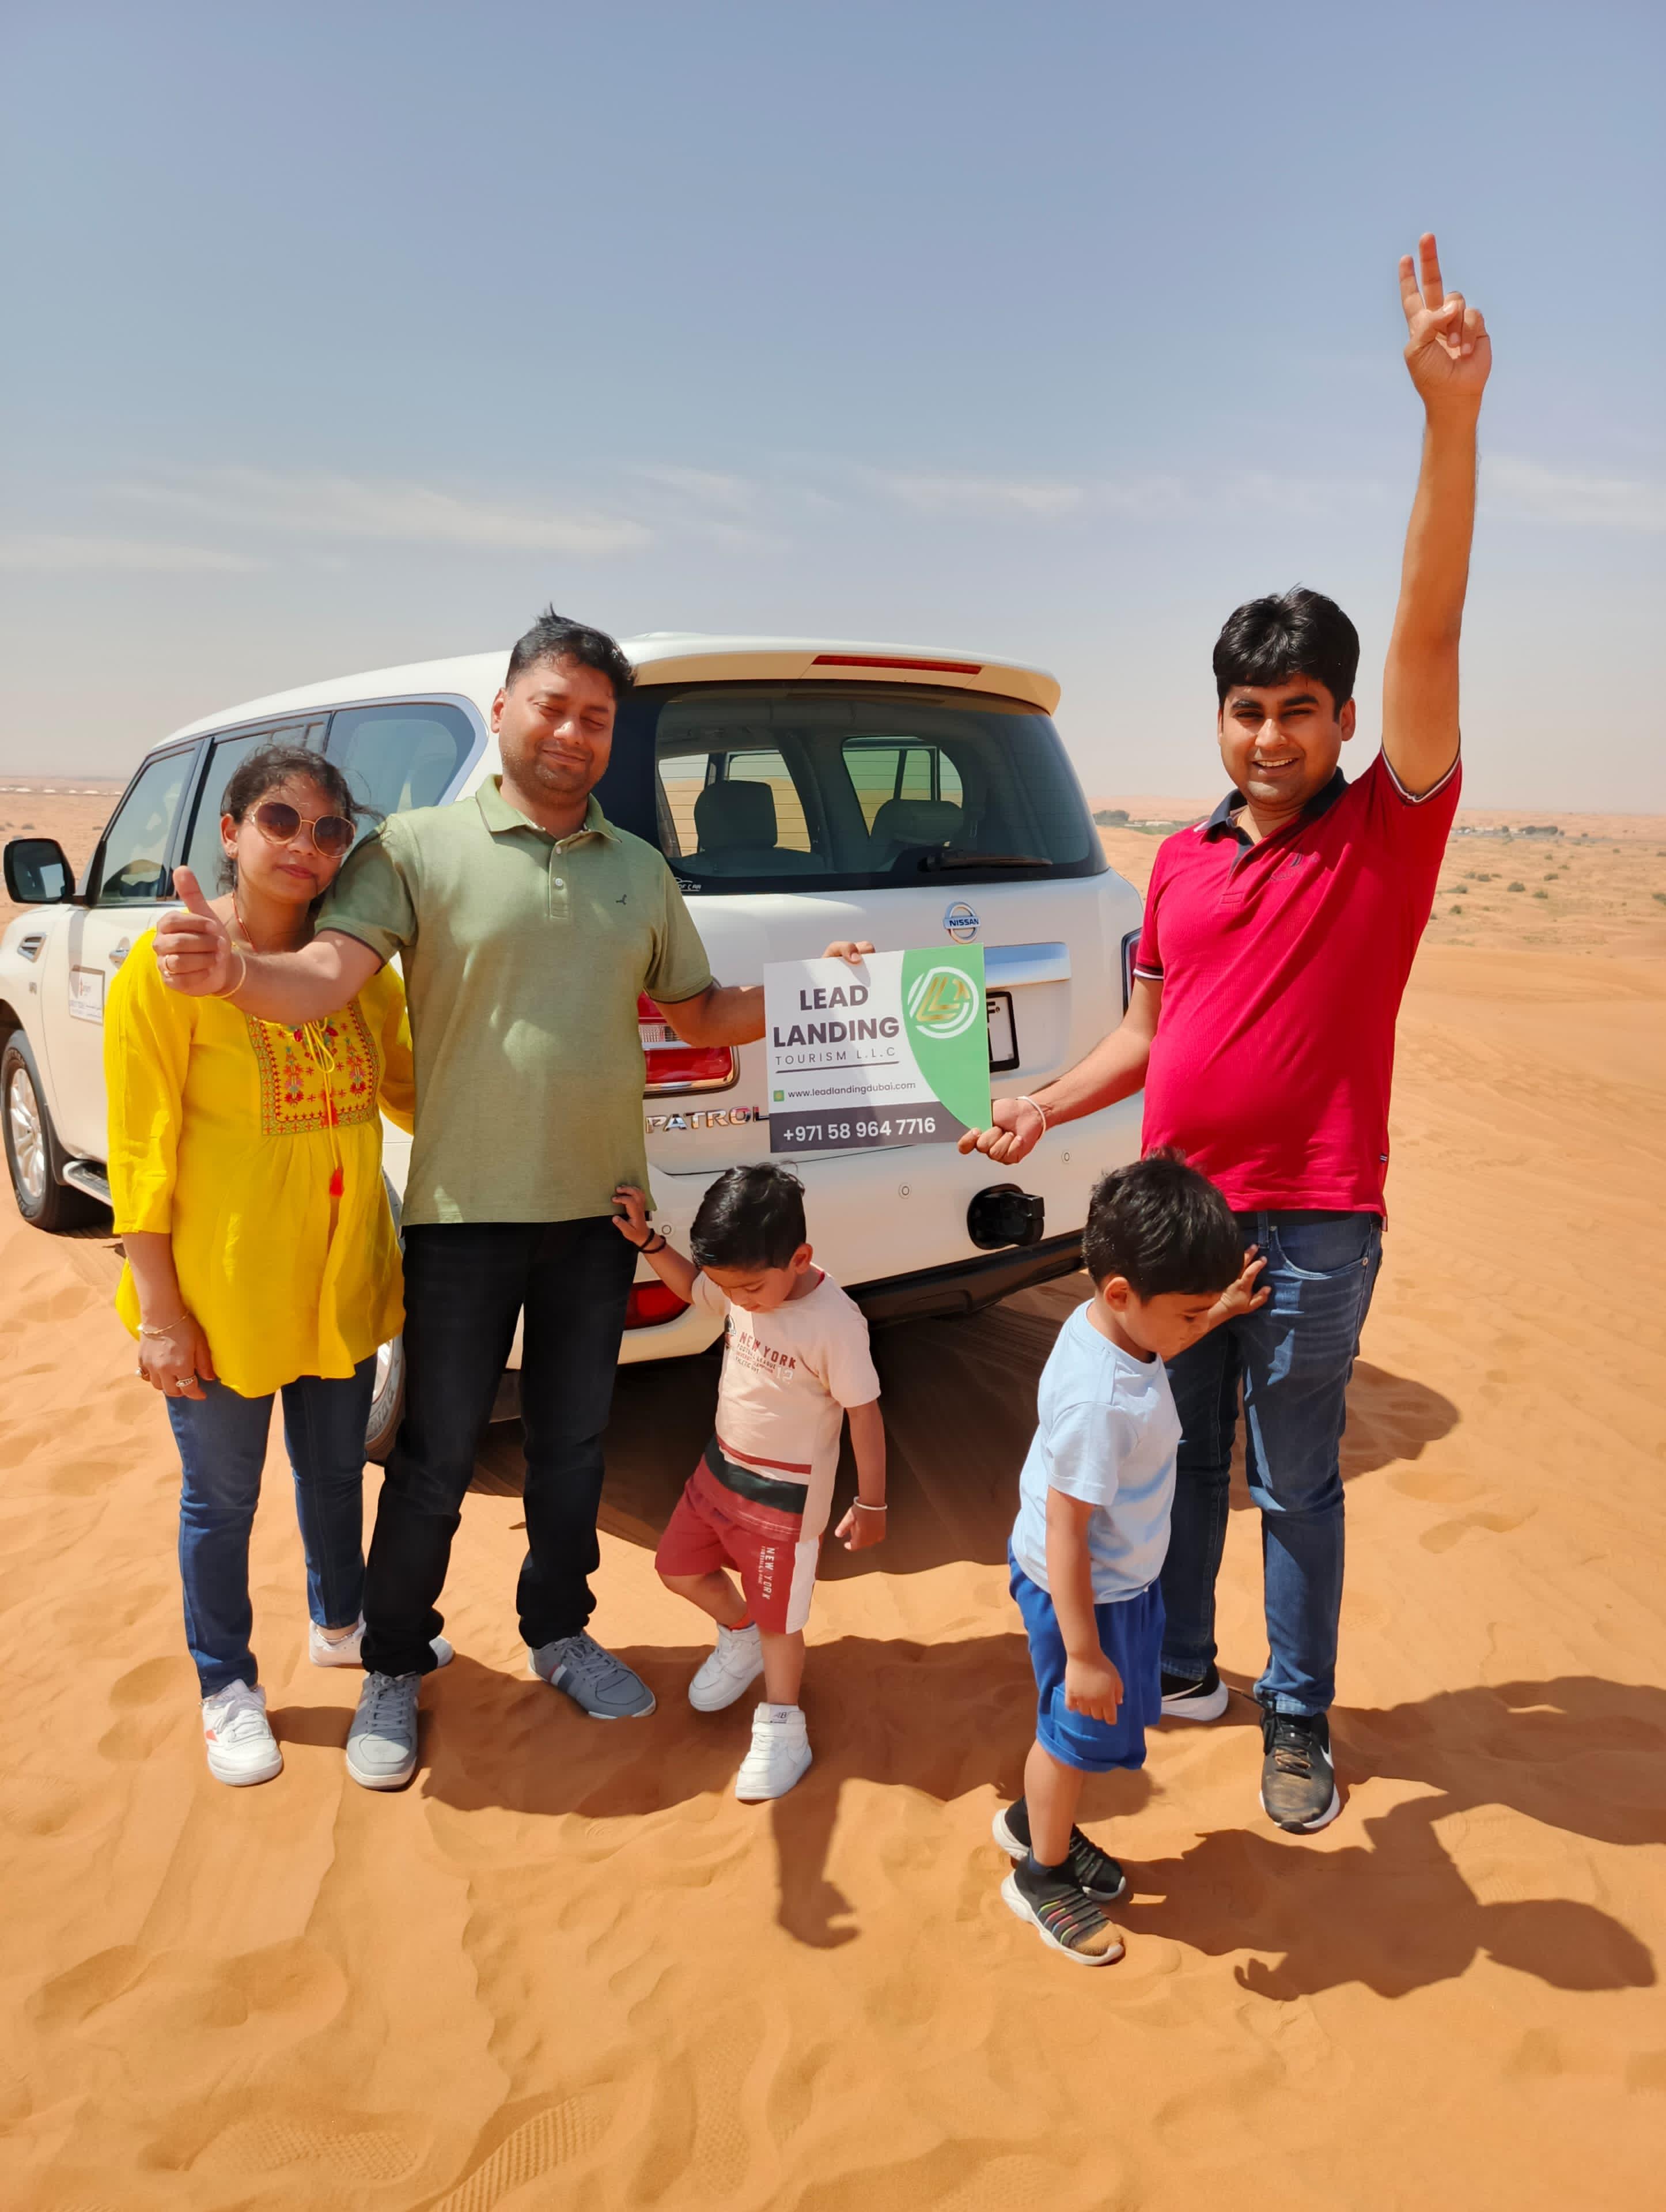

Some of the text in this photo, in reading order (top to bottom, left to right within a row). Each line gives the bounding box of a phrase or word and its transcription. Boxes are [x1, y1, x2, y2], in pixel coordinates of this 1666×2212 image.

[949, 918, 979, 927] NISSAN
[800, 985, 869, 1011] LEAD
[773, 1016, 900, 1048] LANDING
[775, 1046, 895, 1065] TOURISM L.L.C
[787, 1082, 916, 1098] www.leadlandingdubai.com
[645, 1106, 770, 1134] PATROL
[783, 1117, 936, 1142] +971 58 964 7716
[739, 1332, 760, 1352] NEW
[763, 1345, 796, 1370] YORK
[764, 1546, 775, 1571] NEW
[762, 1575, 773, 1600] YORK
